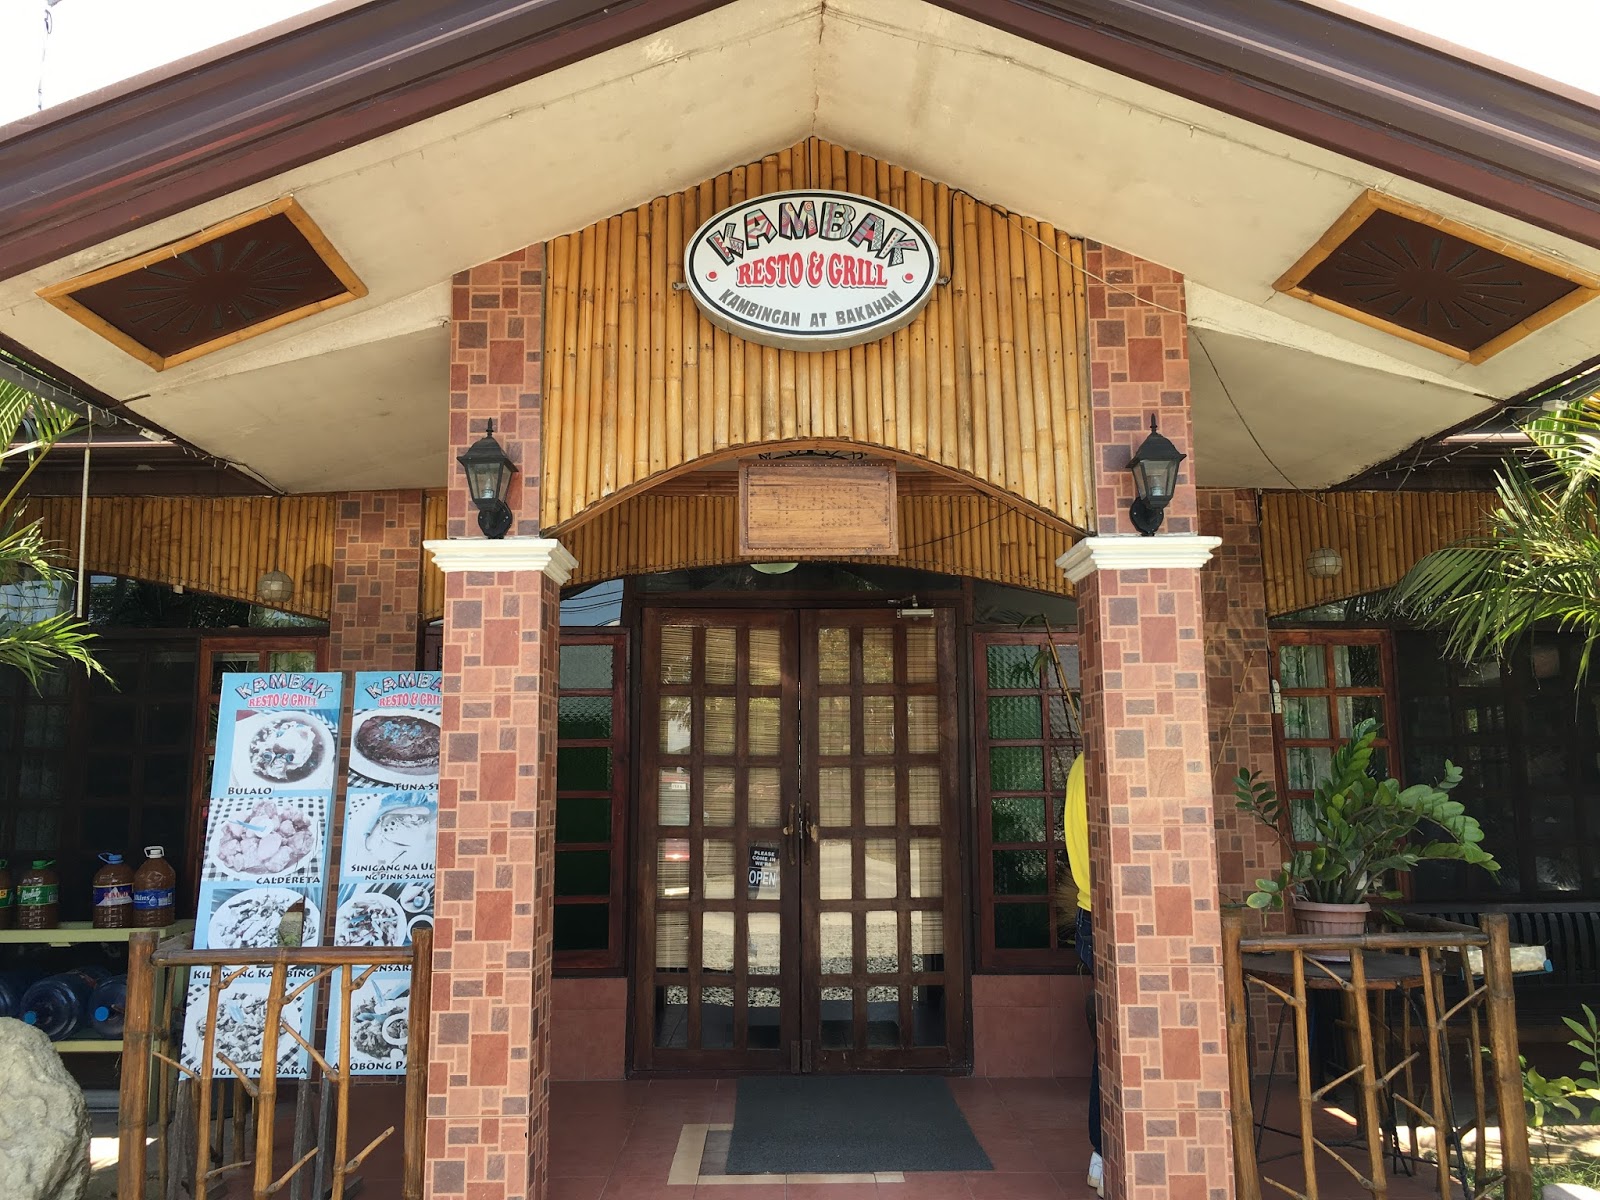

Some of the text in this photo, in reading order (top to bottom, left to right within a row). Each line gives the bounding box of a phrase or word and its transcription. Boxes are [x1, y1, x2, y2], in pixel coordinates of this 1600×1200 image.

[706, 201, 919, 267] KAMBAK
[736, 251, 888, 288] RESTO & GRILL
[718, 289, 903, 327] KAMBINGAN AT BAKAHAN
[235, 673, 333, 699] KAMBAK
[248, 693, 317, 708] RESTO & GRILL
[378, 693, 409, 707] RESTO
[410, 692, 418, 706] &
[228, 787, 272, 795] BULALO
[351, 863, 400, 872] SINIGANG
[421, 862, 436, 871] UL
[256, 876, 320, 884] CALDERETA
[749, 870, 776, 885] OPEN
[193, 969, 314, 979] KILWNG KABING
[333, 1061, 407, 1070] AOBONG P
